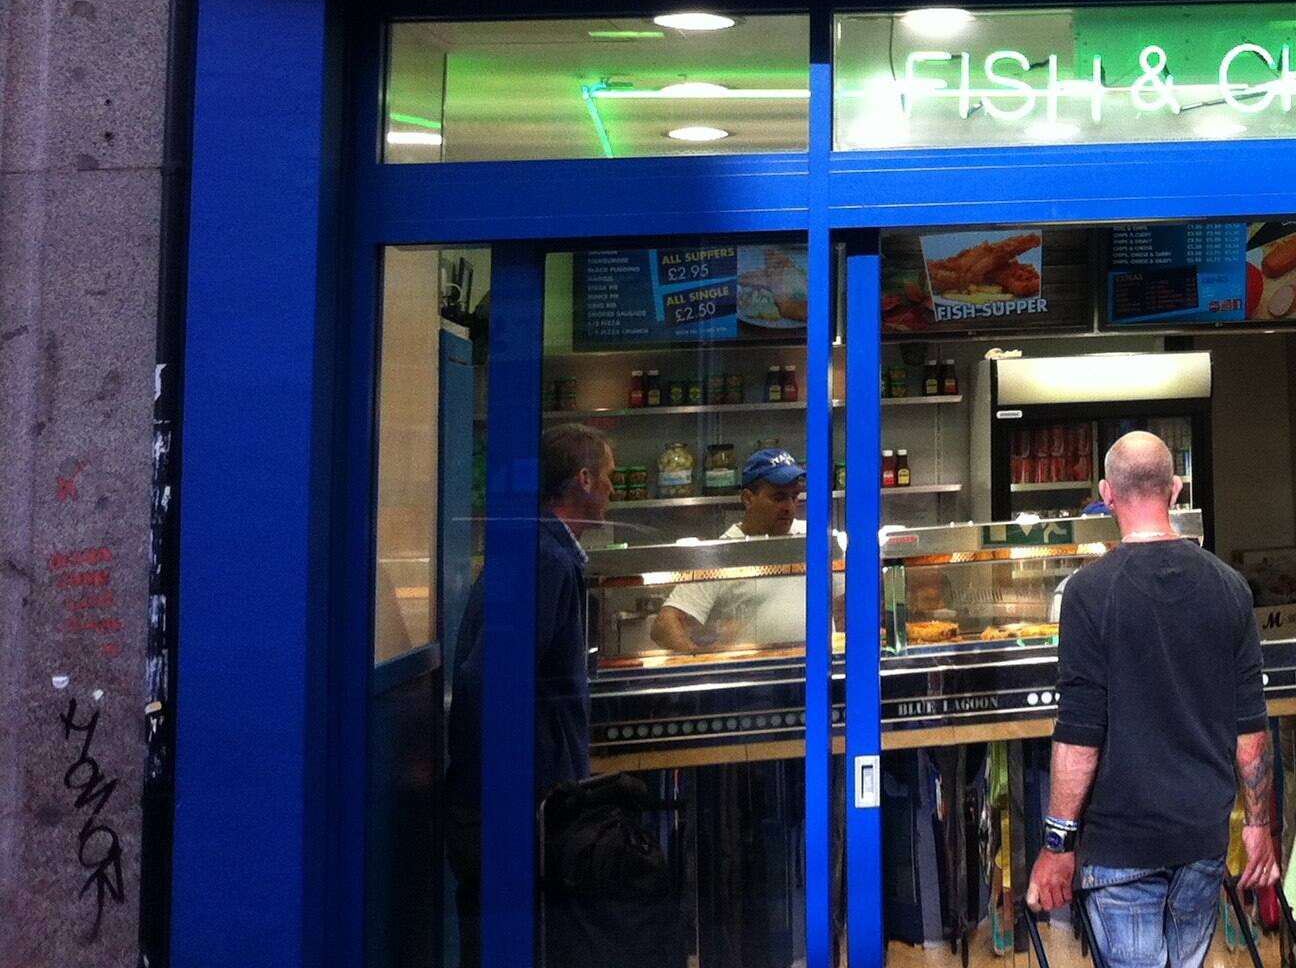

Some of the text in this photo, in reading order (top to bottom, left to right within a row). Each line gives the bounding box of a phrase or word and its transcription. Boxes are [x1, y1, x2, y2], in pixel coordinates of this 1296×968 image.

[902, 49, 1103, 124] FISH
[1130, 44, 1182, 114] &
[662, 247, 736, 266] ALL SUPPERS
[668, 263, 710, 282] £2.95
[666, 286, 730, 307] ALL SINGLE
[674, 302, 717, 323] £2.50
[937, 298, 1049, 321] FISH SUPPER
[898, 695, 999, 716] BLUE LAGOON
